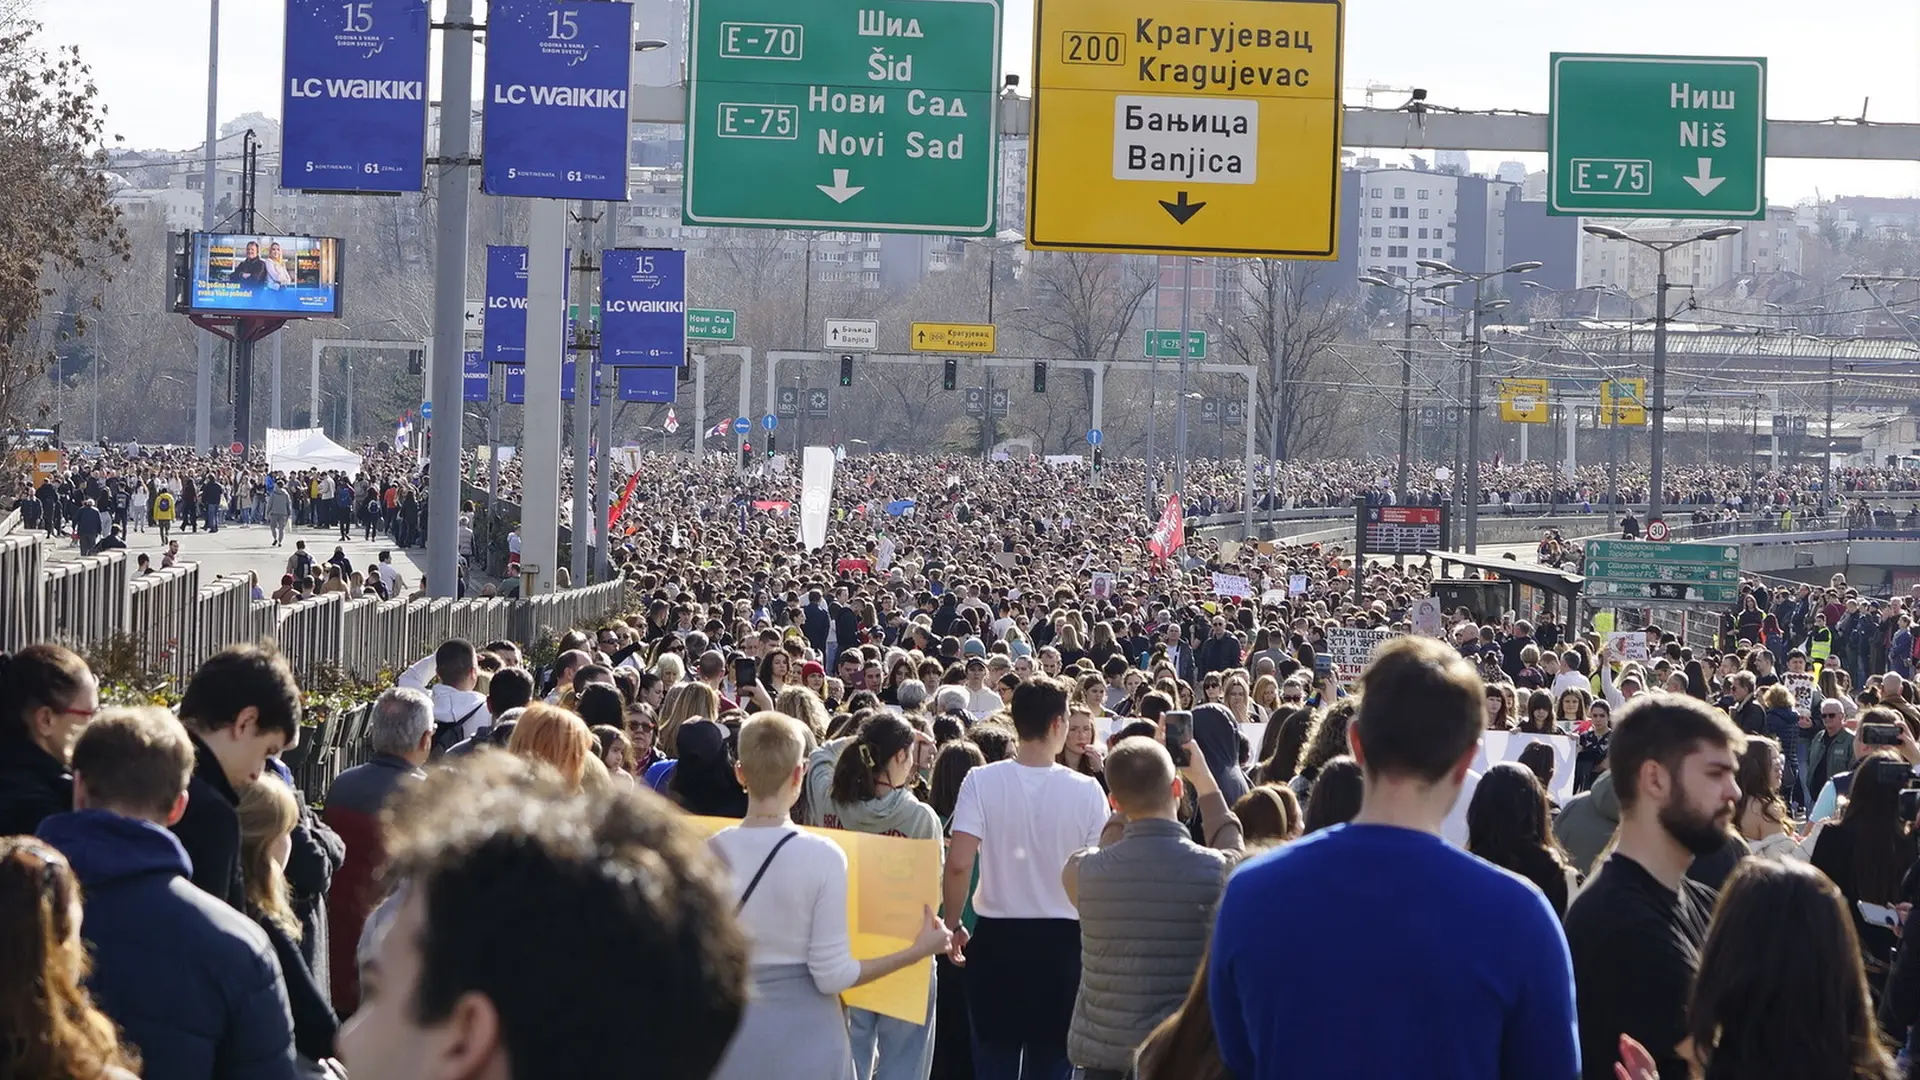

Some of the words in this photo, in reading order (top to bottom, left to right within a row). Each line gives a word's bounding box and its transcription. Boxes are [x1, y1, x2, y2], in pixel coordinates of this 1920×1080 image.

[343, 2, 373, 32] 15
[548, 9, 579, 40] 15
[858, 9, 924, 38] Шид
[728, 27, 795, 55] E-70
[1136, 18, 1313, 53] Крагујевац
[1069, 35, 1119, 62] 200
[868, 47, 912, 81] Šid
[1139, 56, 1309, 90] Kragujevac
[291, 78, 322, 98] LC
[494, 84, 527, 104] LC
[1670, 83, 1735, 109] Ниш
[808, 85, 885, 114] Нови
[907, 89, 967, 117] Сад
[725, 108, 791, 134] E-75
[1126, 105, 1248, 137] Бањица
[818, 129, 884, 157] Novi
[906, 131, 964, 159] Sad
[1680, 121, 1727, 147] Niš
[305, 161, 313, 172] 5
[364, 162, 379, 174] 61
[1128, 145, 1242, 178] Banjica
[508, 168, 516, 179] 5
[567, 170, 582, 182] 61
[1578, 163, 1644, 190] E-75
[520, 253, 528, 270] 1
[636, 256, 654, 274] 15
[489, 297, 508, 308] LC
[606, 300, 626, 312] LC
[689, 314, 710, 323] Нови
[715, 315, 731, 323] Сад
[689, 325, 707, 333] Novi
[711, 326, 727, 334] Sad
[842, 326, 871, 334] Бањица
[842, 336, 869, 344] Banjica
[947, 329, 989, 338] Крагујевац
[947, 339, 987, 348] Kragujevac
[467, 353, 476, 361] 15
[1651, 525, 1664, 536] 30
